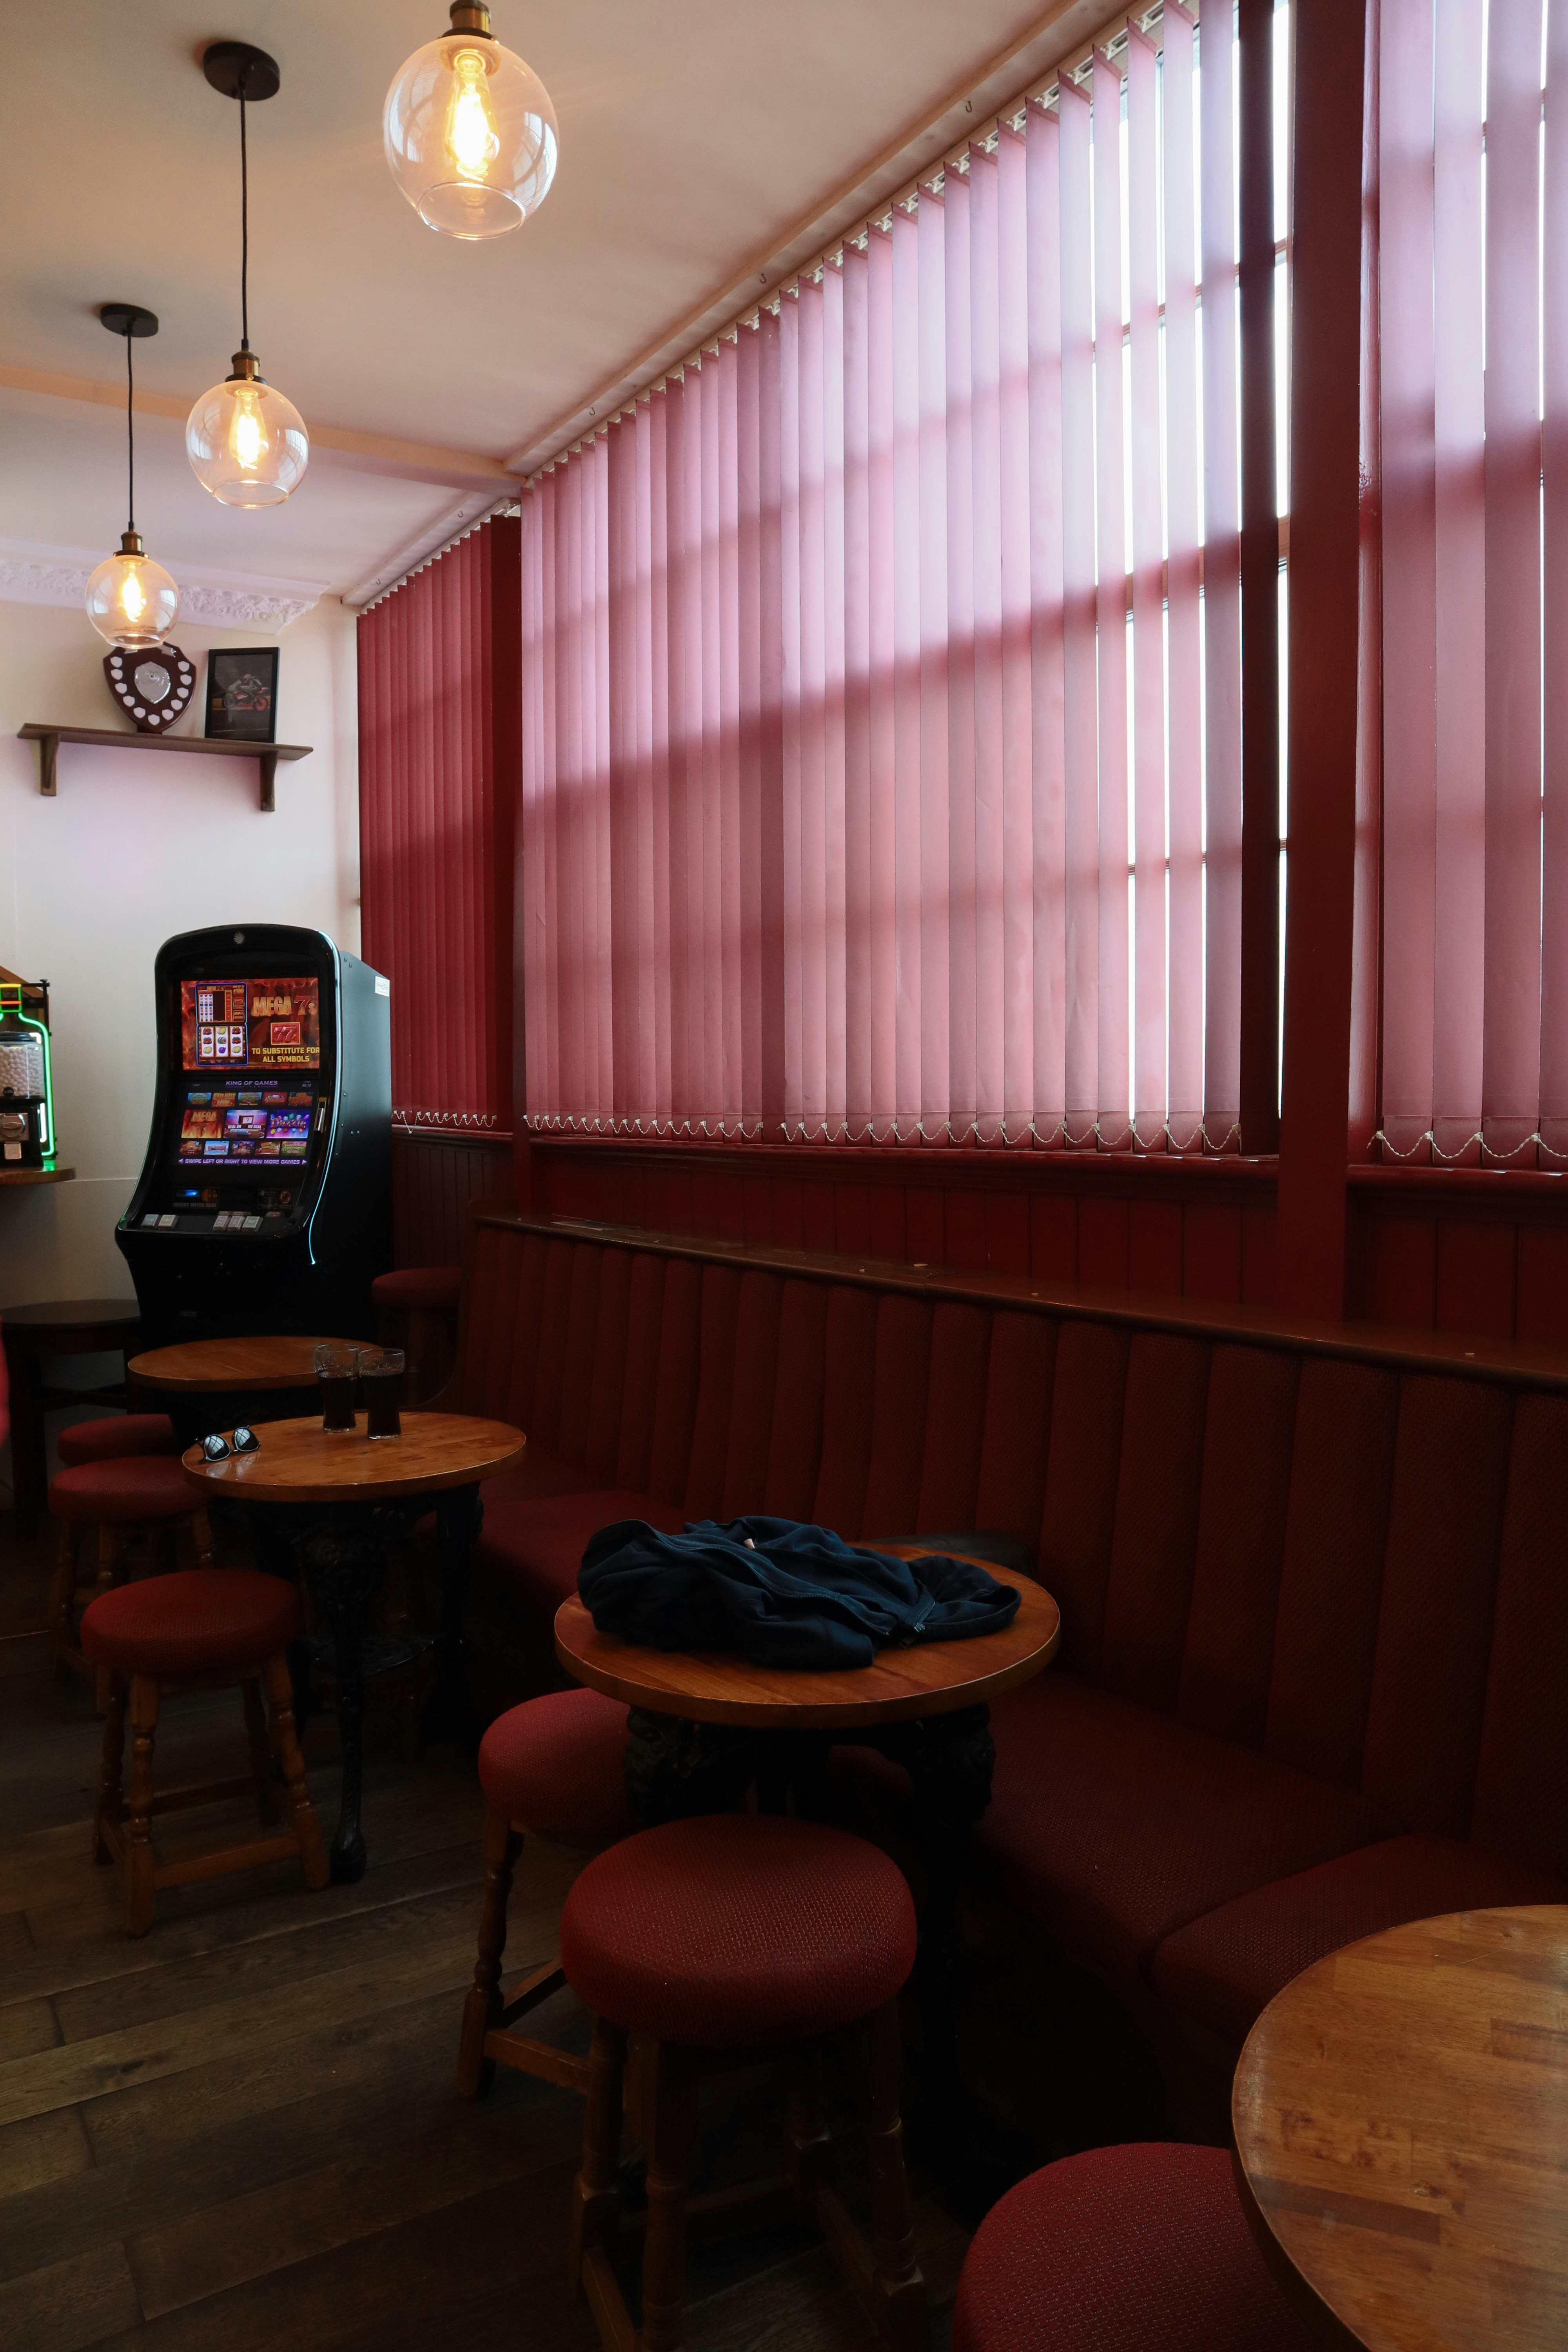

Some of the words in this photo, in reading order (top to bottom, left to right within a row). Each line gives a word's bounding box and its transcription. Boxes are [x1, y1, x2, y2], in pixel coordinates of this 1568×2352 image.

[251, 996, 292, 1016] MEGA
[191, 1111, 216, 1122] MEGA
[270, 1118, 306, 1129] Dazzle
